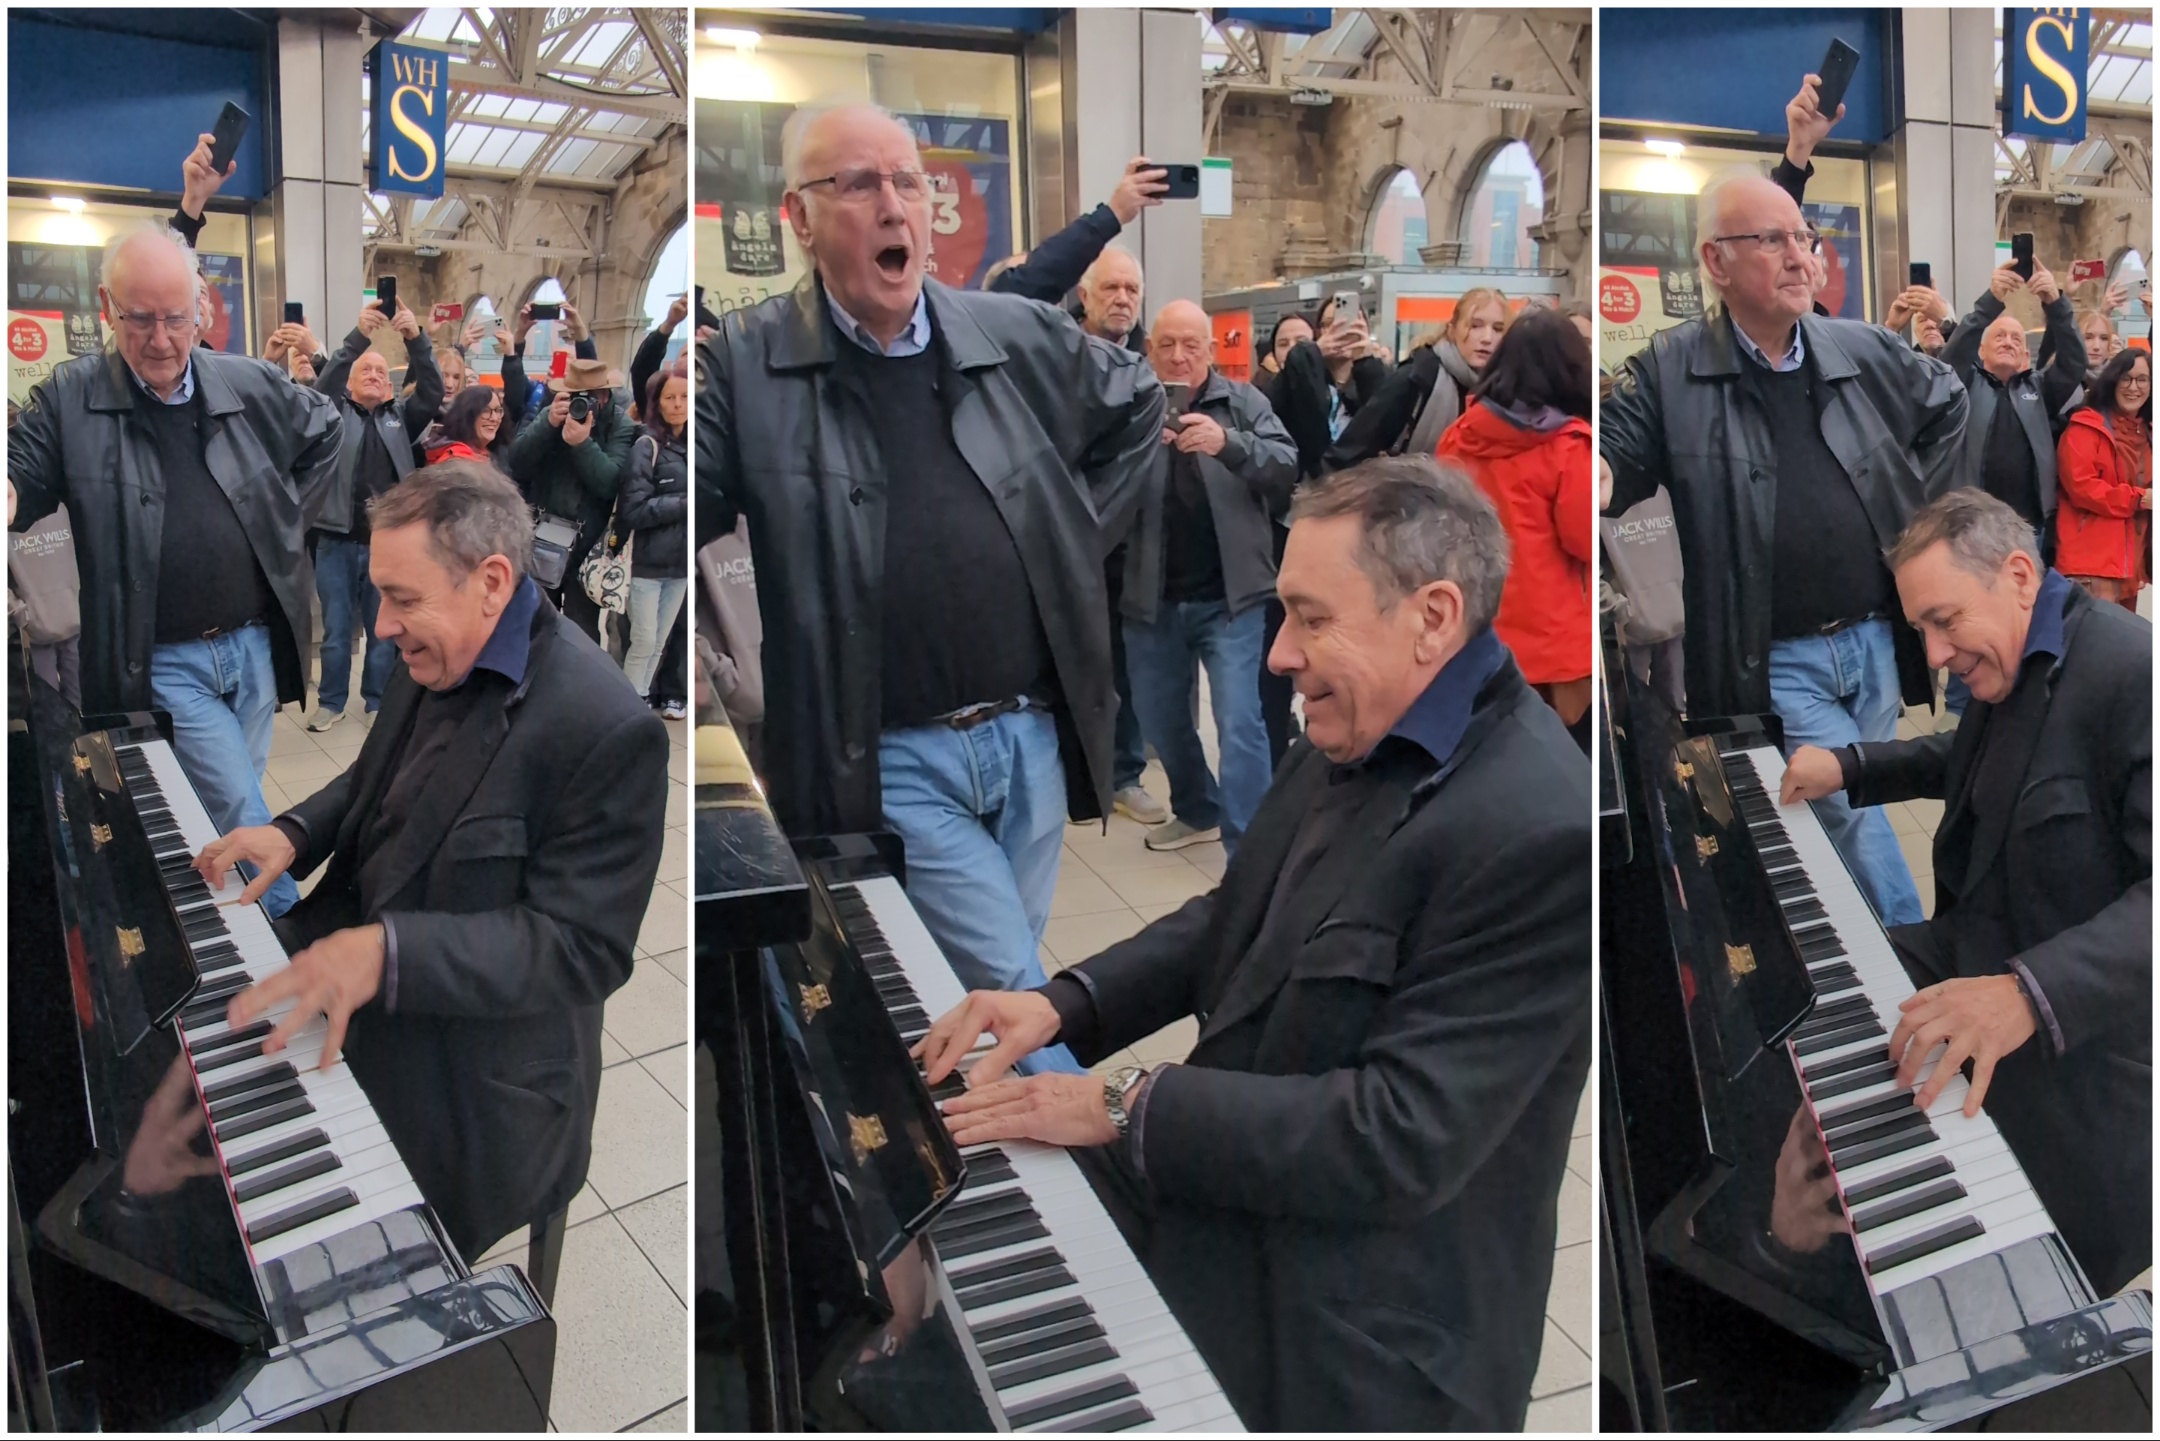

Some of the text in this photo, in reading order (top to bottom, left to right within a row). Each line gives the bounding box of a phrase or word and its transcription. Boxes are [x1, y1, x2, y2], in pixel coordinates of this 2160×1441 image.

[391, 53, 439, 87] WH
[2023, 15, 2078, 125] S
[388, 84, 437, 182] S
[1600, 291, 1613, 306] 4
[1623, 291, 1635, 306] 3
[12, 332, 23, 346] 4
[32, 332, 42, 346] 3
[1613, 515, 1673, 538] JACK WILLS
[14, 529, 70, 551] JACK WILLS
[716, 557, 755, 578] JACK
